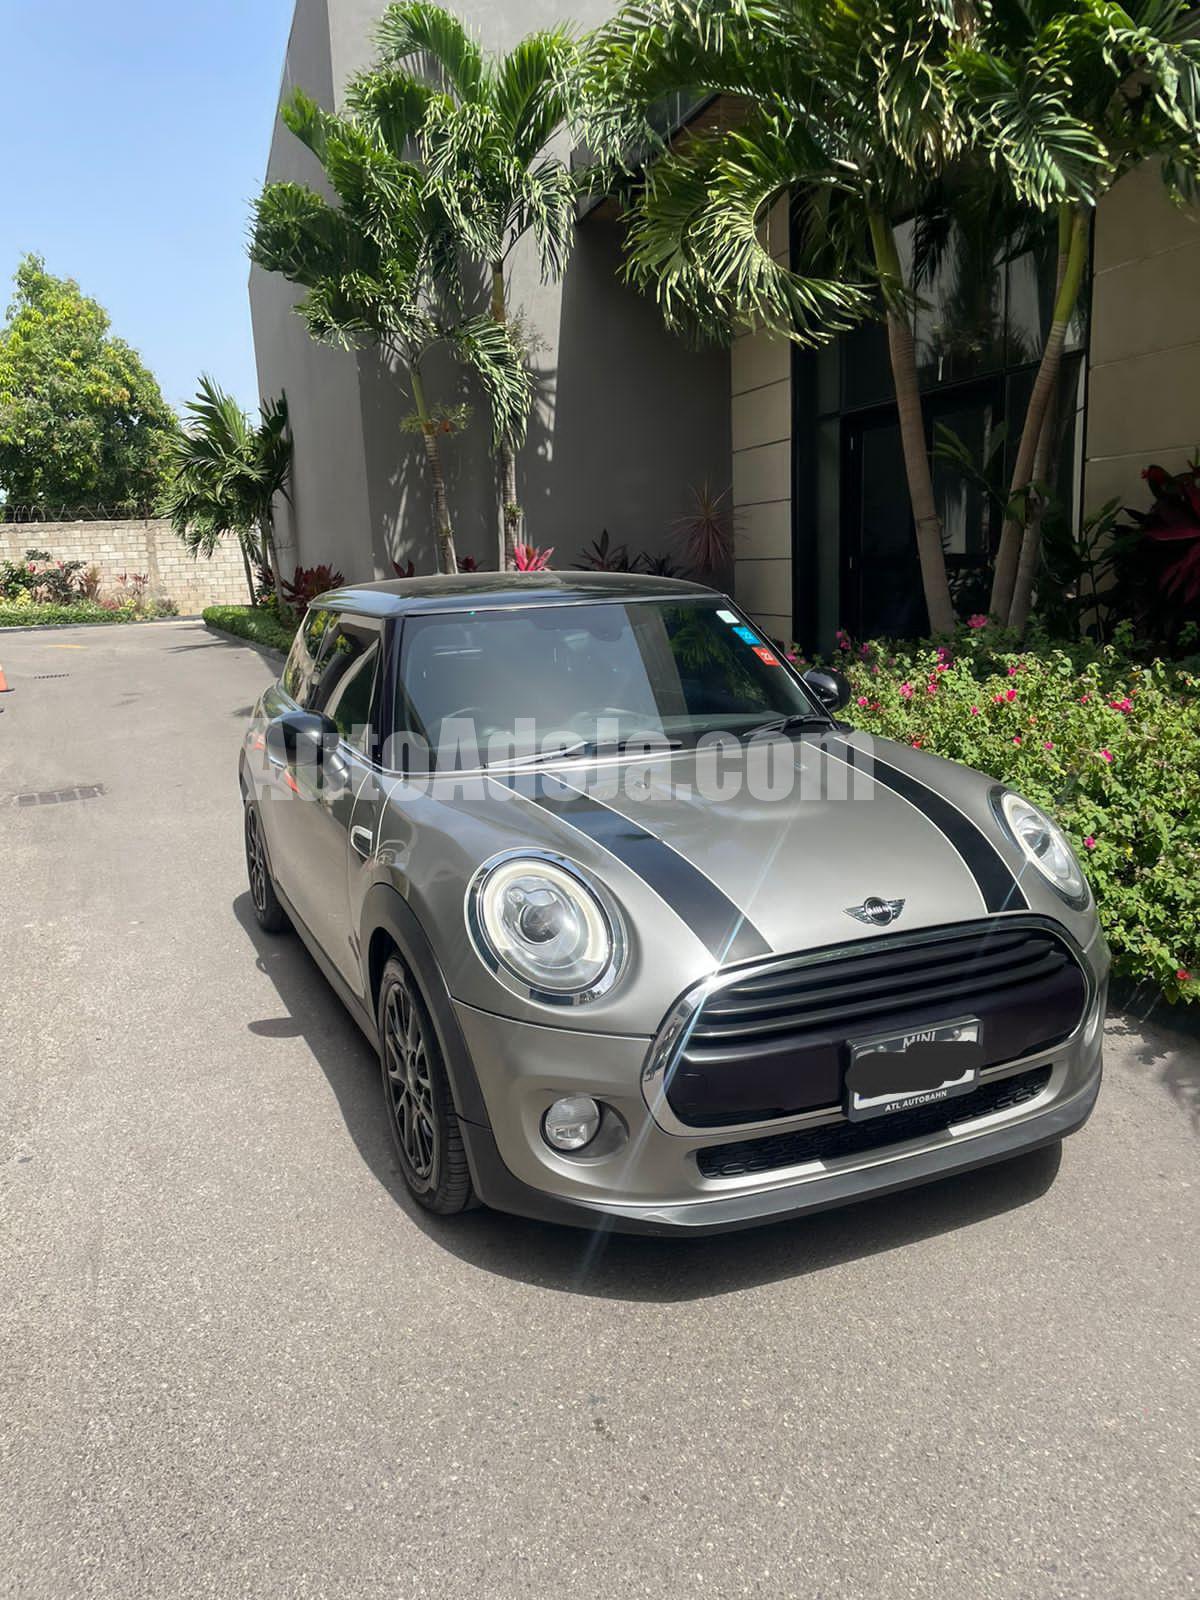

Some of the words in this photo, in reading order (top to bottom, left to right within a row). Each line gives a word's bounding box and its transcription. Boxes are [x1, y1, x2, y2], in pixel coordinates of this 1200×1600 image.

[902, 1031, 936, 1049] MINI
[884, 1103, 901, 1112] ATL
[902, 1090, 948, 1107] AUTOBAHN
